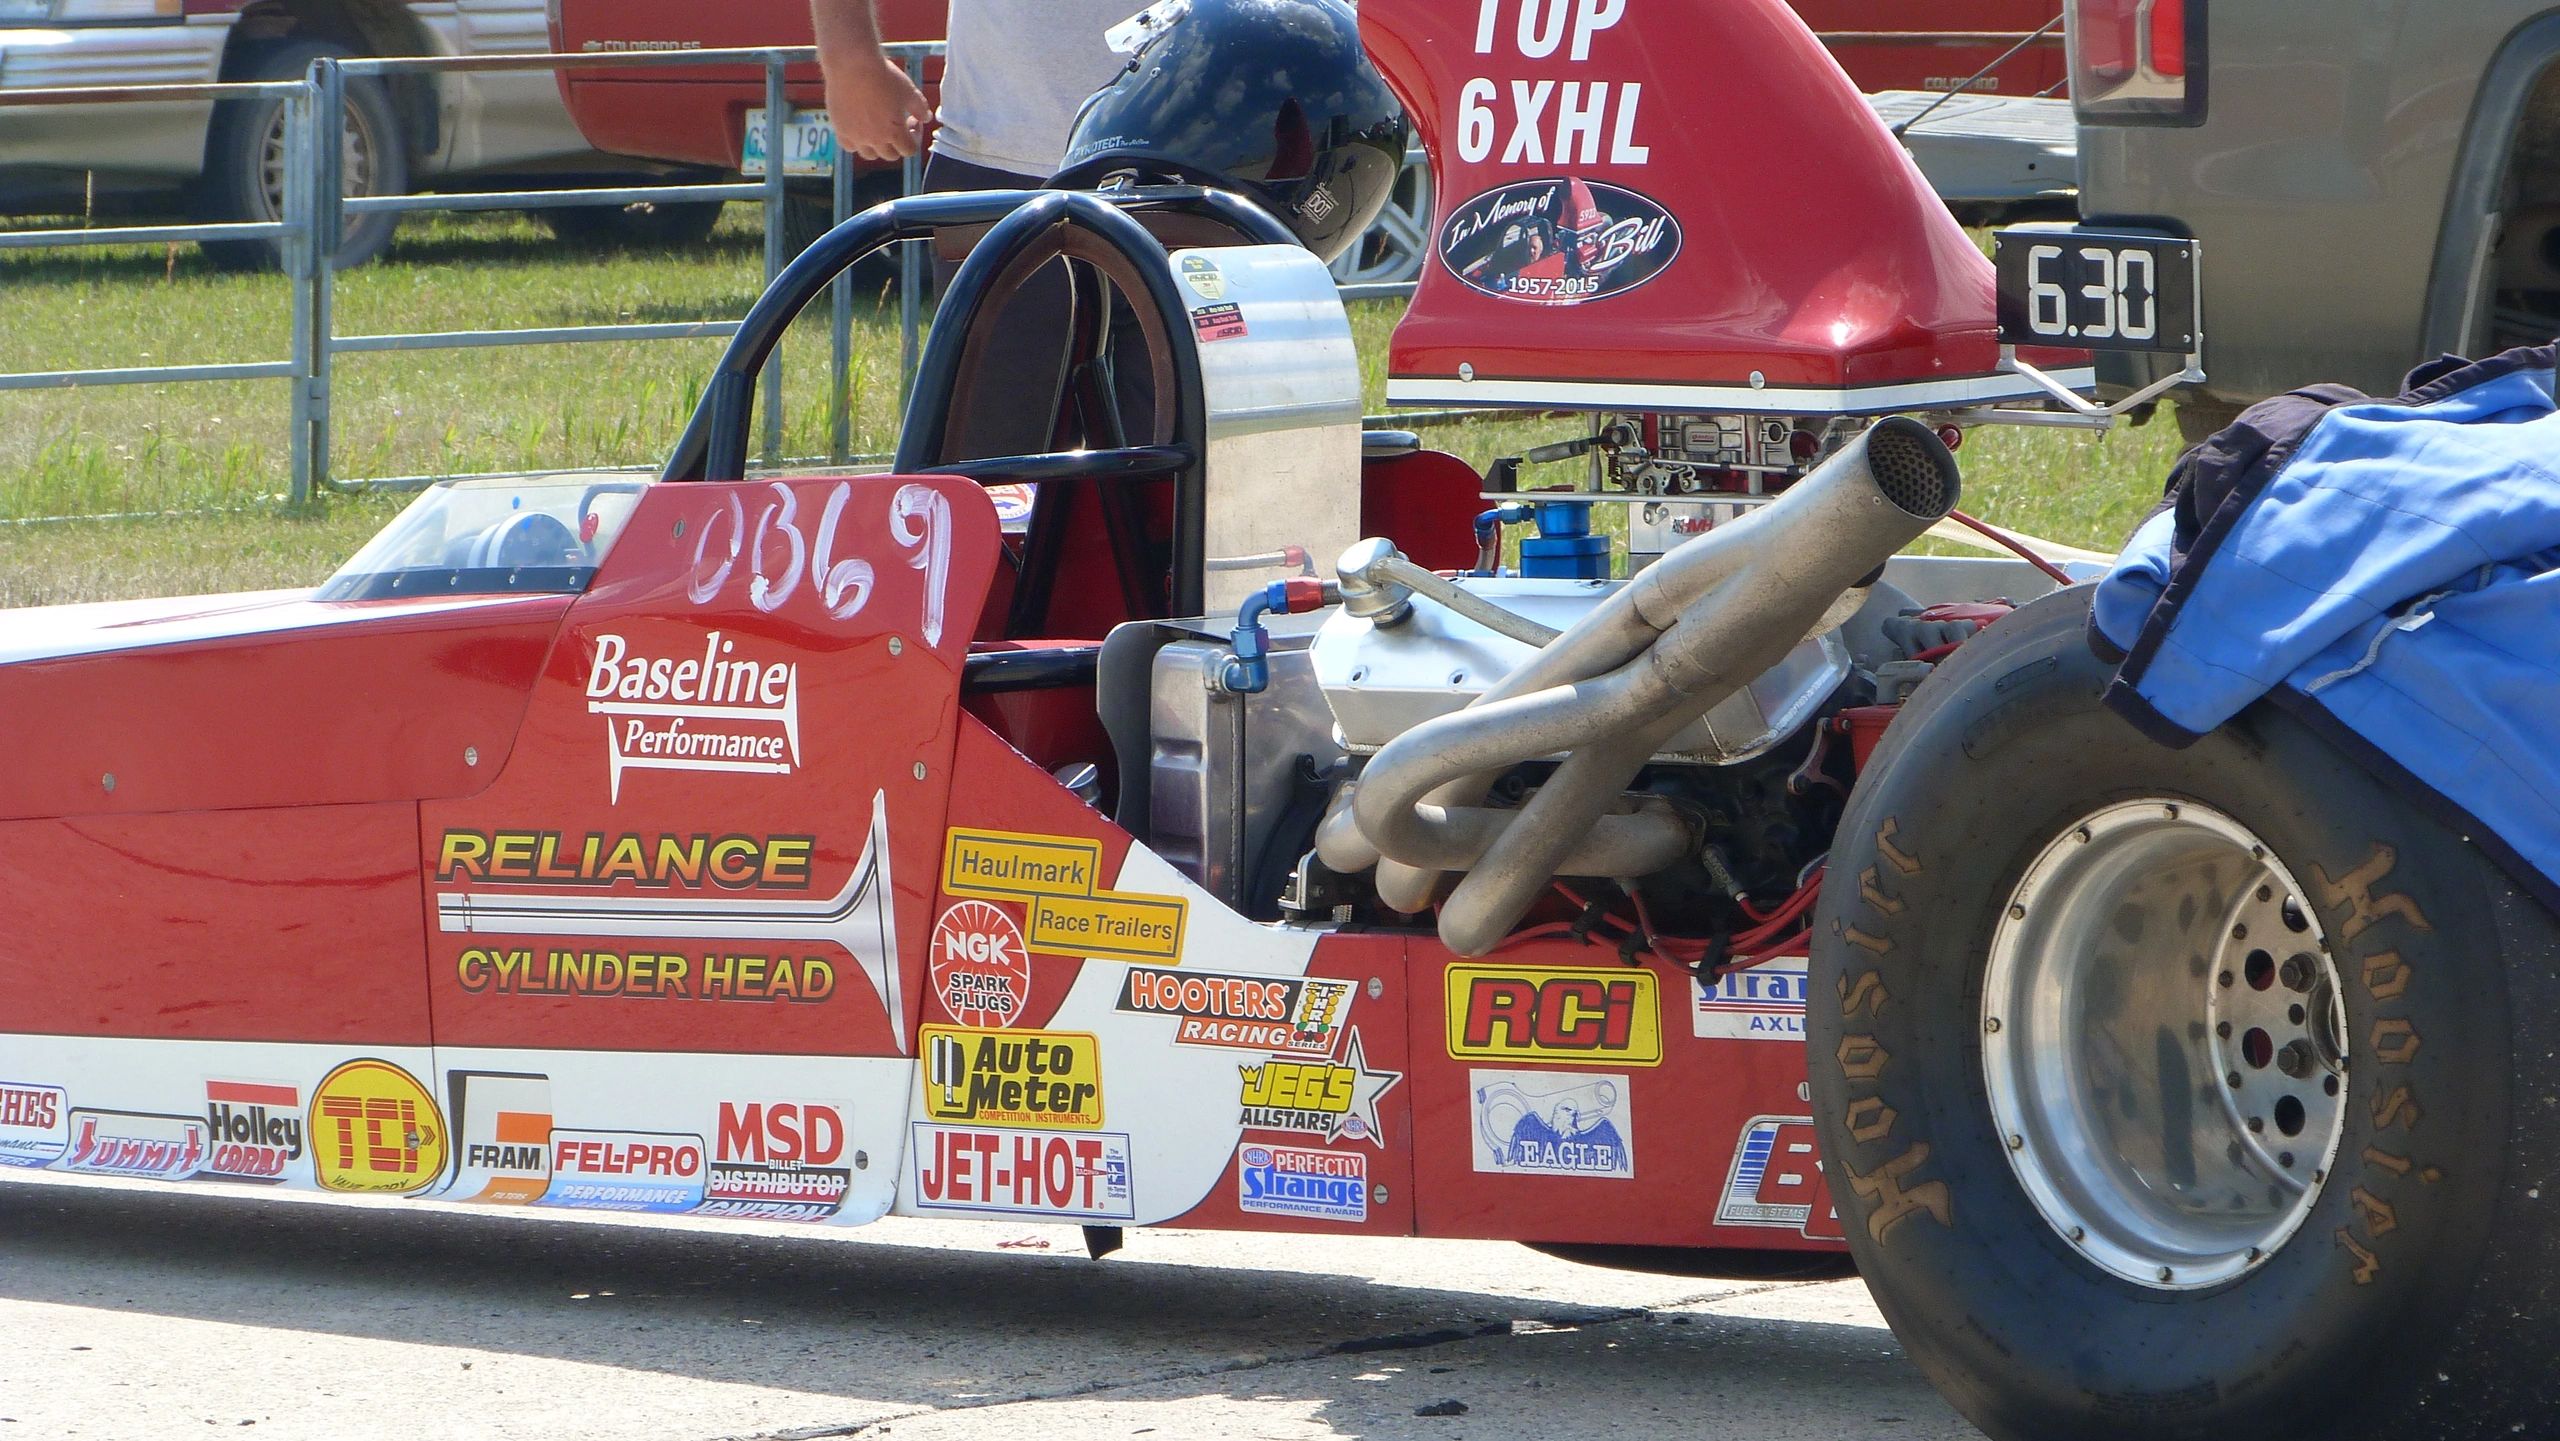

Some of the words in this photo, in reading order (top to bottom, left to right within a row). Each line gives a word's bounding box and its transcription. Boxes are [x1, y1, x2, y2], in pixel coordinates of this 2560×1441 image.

[1457, 77, 1650, 164] 6XHL
[1307, 193, 1331, 217] DOT
[1446, 219, 1471, 254] In
[1470, 192, 1537, 237] Memory
[1537, 186, 1556, 213] of
[1591, 216, 1667, 271] Bill
[1508, 275, 1600, 295] 1957-2015
[2028, 245, 2156, 340] 6.30
[585, 630, 792, 705] Baseline
[623, 717, 784, 760] Performance
[435, 829, 815, 889] RELIANCE
[961, 849, 1086, 885] Haulmark
[1039, 909, 1090, 933] Race
[1095, 914, 1173, 940] Trailers
[945, 930, 1011, 966] NGK
[454, 947, 692, 998] CYLINDER
[700, 953, 838, 1003] HEAD
[950, 972, 1011, 994] SPARK
[951, 992, 1013, 1013] PLUGS
[1131, 970, 1287, 1020] HOOTERS
[1183, 1020, 1287, 1045] RACING
[1288, 1040, 1326, 1050] SERIES
[974, 1036, 1074, 1076] Auto
[968, 1074, 1096, 1114] Meter
[1240, 1060, 1357, 1113] JEG'S
[0, 1088, 58, 1130] HES
[978, 1110, 1031, 1122] COMPETITION
[1035, 1112, 1091, 1125] INSTRUMENTS
[1239, 1107, 1332, 1132] ALLSTARS
[208, 1102, 302, 1161] Holley
[322, 1095, 419, 1174] TCI
[716, 1101, 844, 1166] MSD
[212, 1144, 288, 1176] CARBS
[468, 1144, 542, 1171] FRAM
[554, 1140, 700, 1177] FEL-PRO
[768, 1159, 804, 1171] BILLET
[922, 1131, 1103, 1209] JET-HOT
[1246, 1150, 1269, 1164] NHRA
[1276, 1153, 1361, 1178] PERFECTLY
[1519, 1139, 1614, 1172] EAGLE
[558, 1184, 689, 1204] PERFORMANCE
[710, 1169, 849, 1197] DISTRIBUTOR
[1243, 1164, 1364, 1207] Strange
[693, 1200, 832, 1221] IGNITION
[1242, 1200, 1322, 1213] PERFORMANCE
[1324, 1207, 1364, 1217] AWARD
